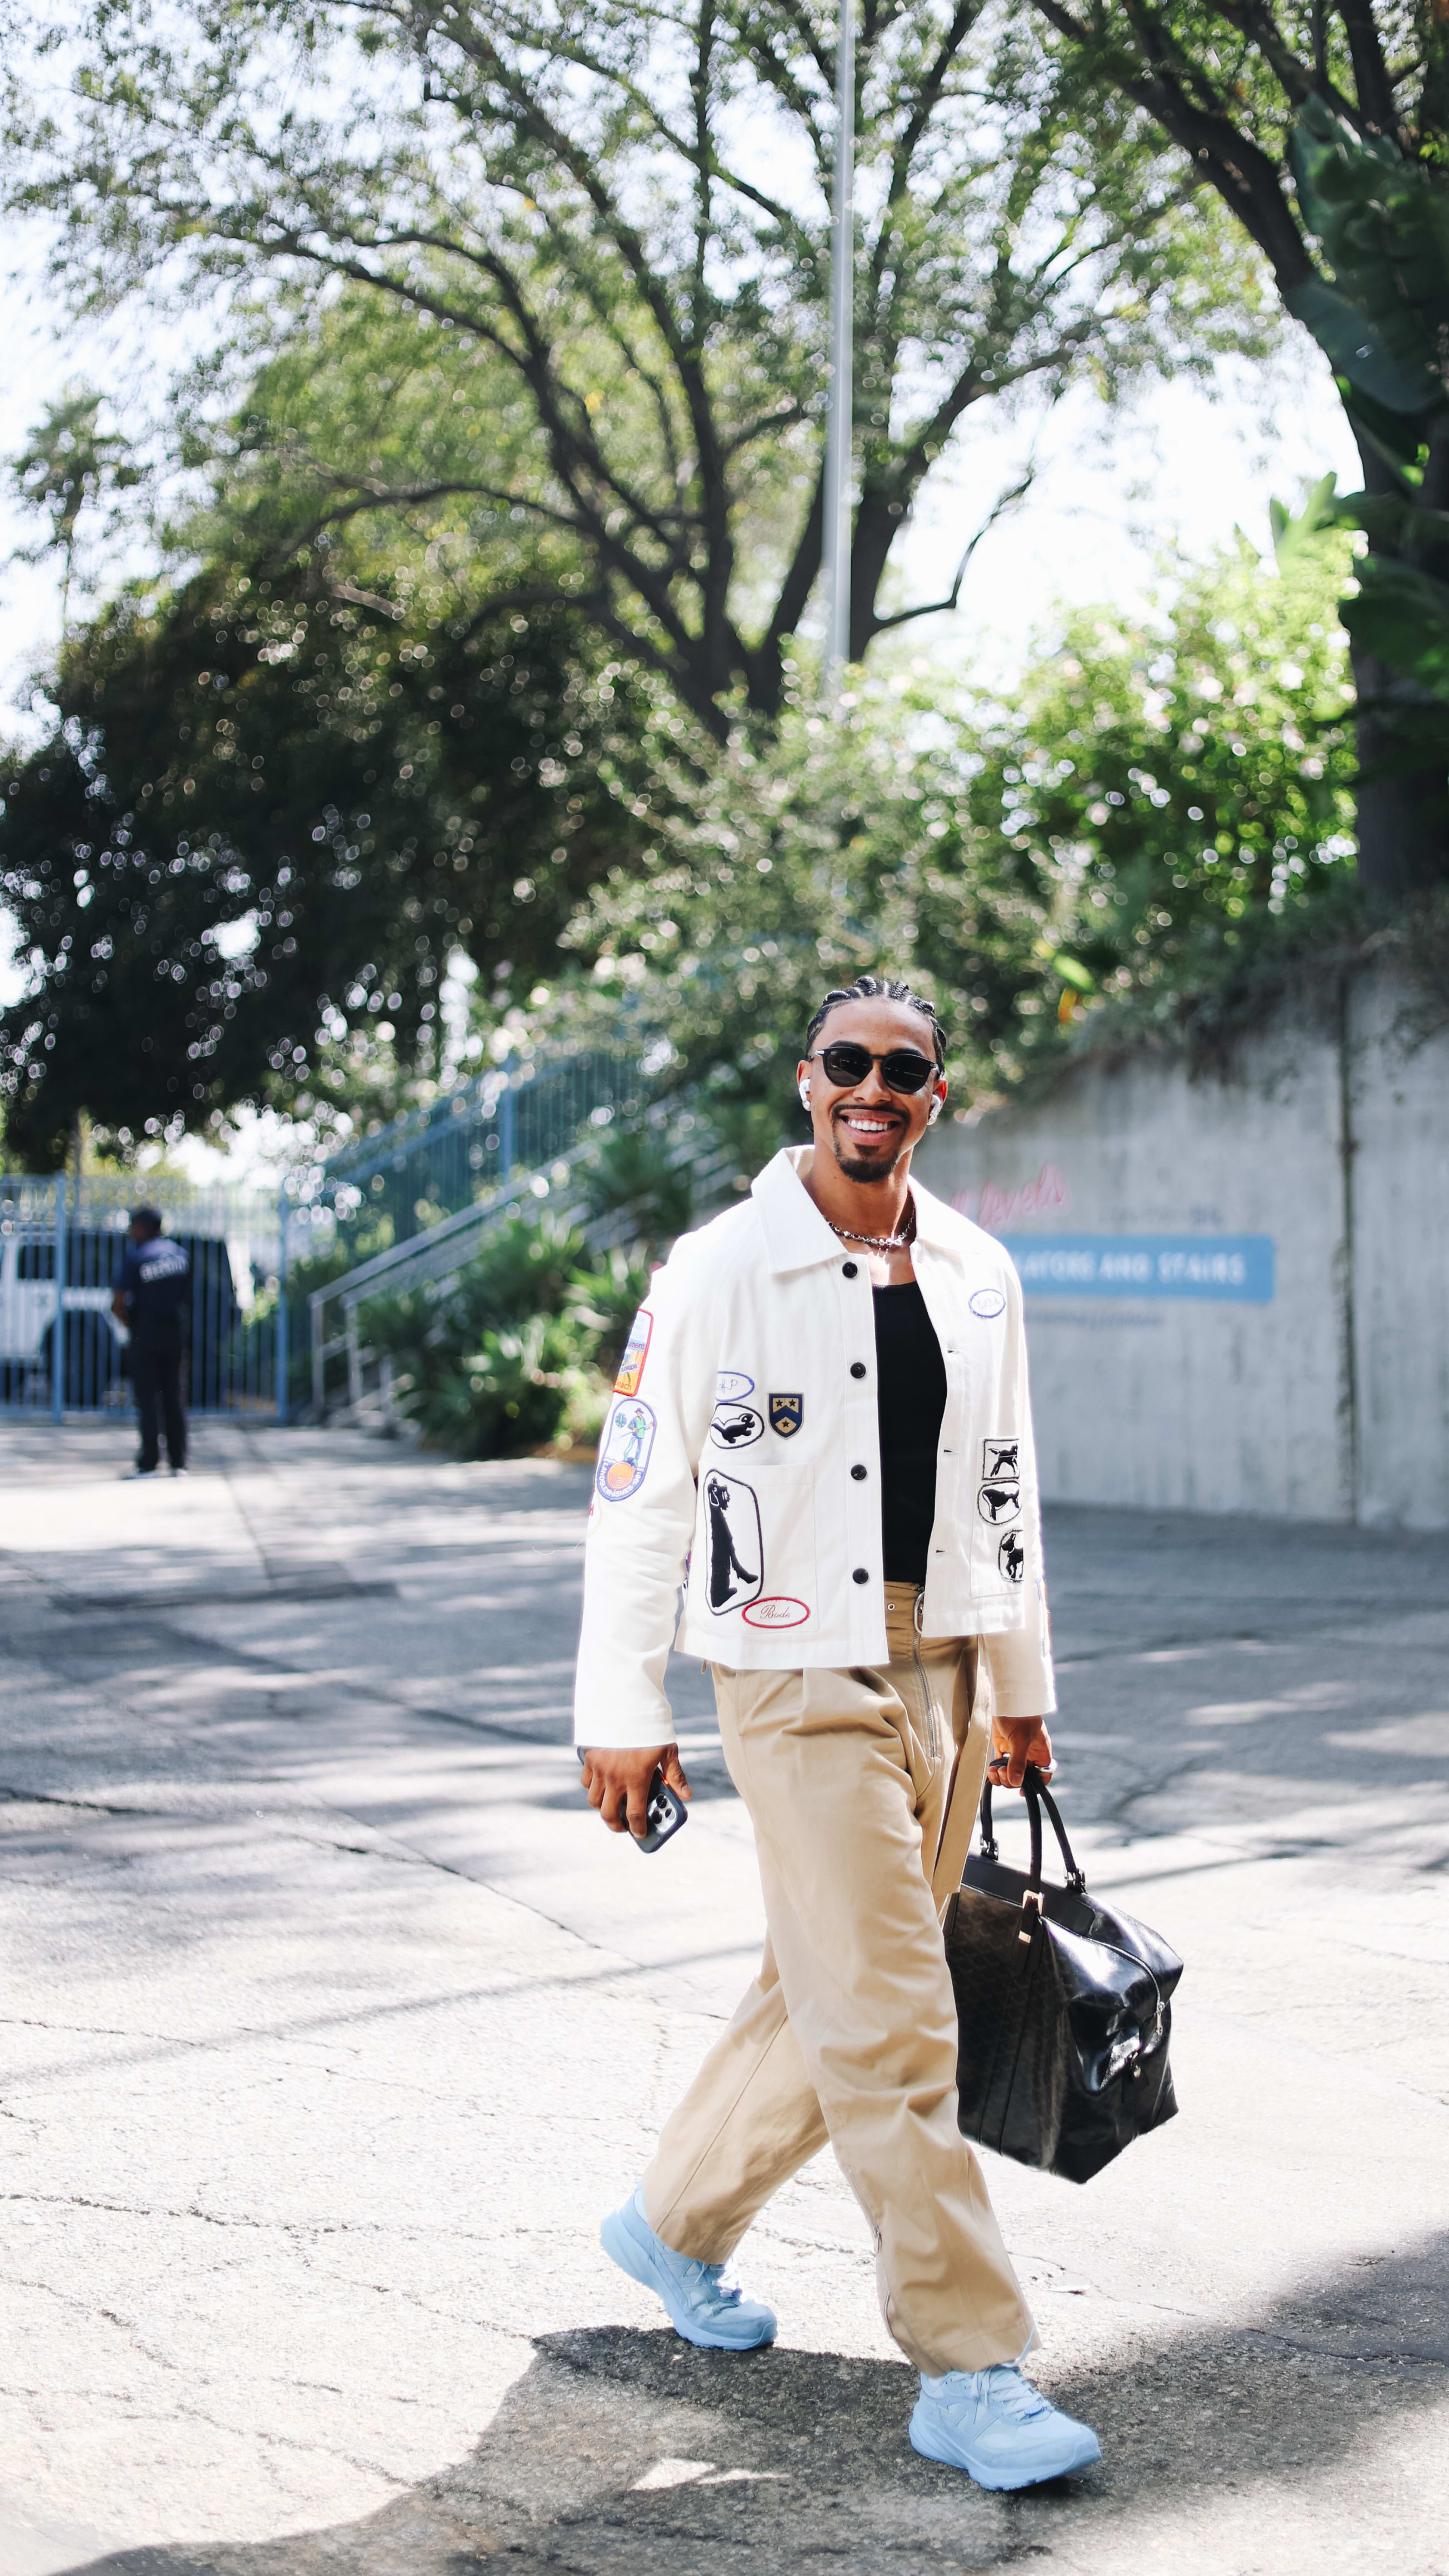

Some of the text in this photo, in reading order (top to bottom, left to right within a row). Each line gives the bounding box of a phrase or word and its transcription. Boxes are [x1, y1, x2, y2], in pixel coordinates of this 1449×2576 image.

[1100, 1251, 1155, 1282] AND
[1158, 1251, 1248, 1286] STAIRS
[760, 1604, 791, 1619] Bode
